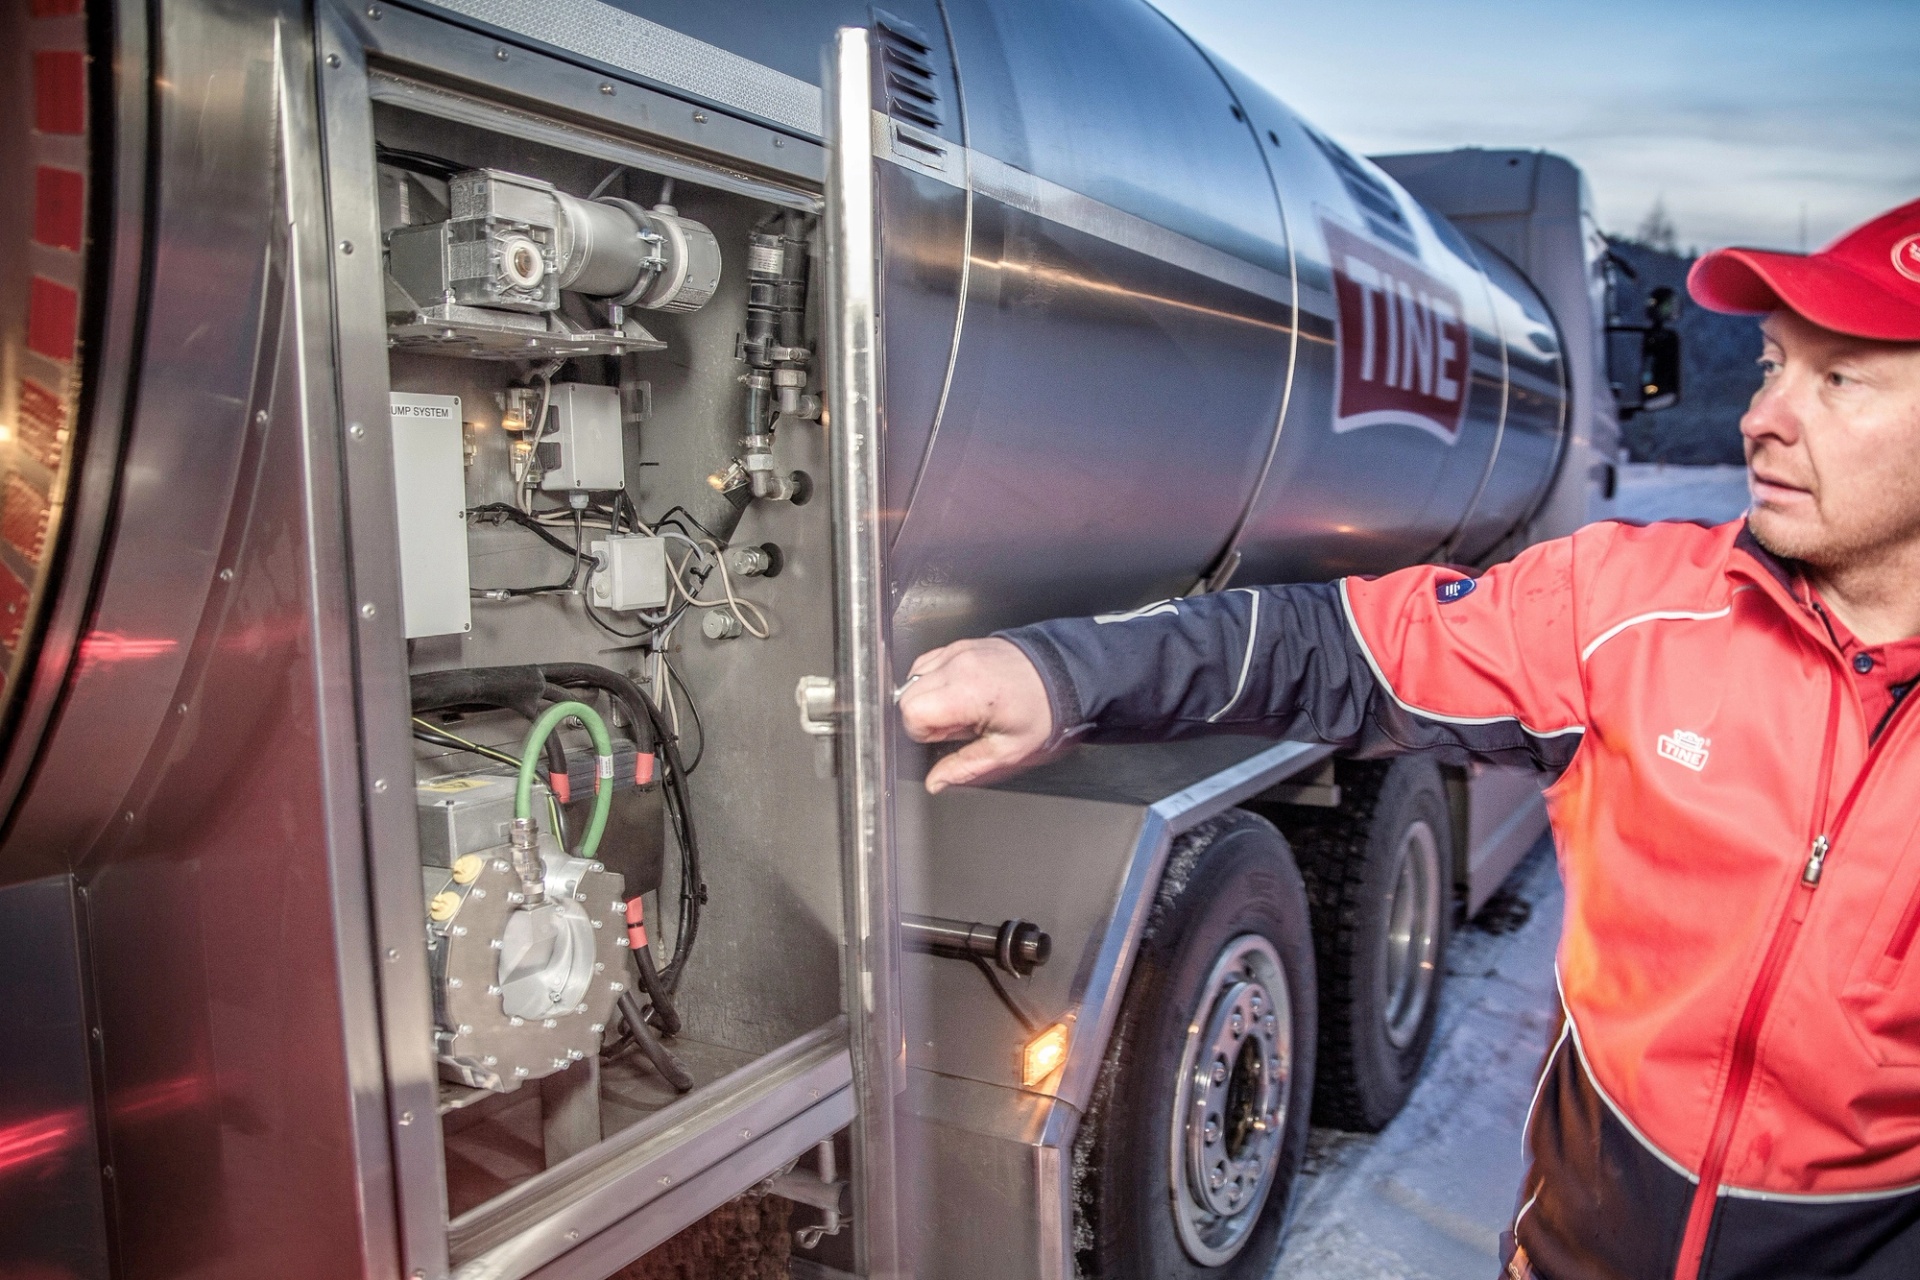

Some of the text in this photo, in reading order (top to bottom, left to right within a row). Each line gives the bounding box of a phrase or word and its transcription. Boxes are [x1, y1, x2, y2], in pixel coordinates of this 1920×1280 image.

[1345, 254, 1459, 402] TINE
[390, 405, 449, 418] UMP SYSTEM
[1664, 741, 1702, 767] TINE
